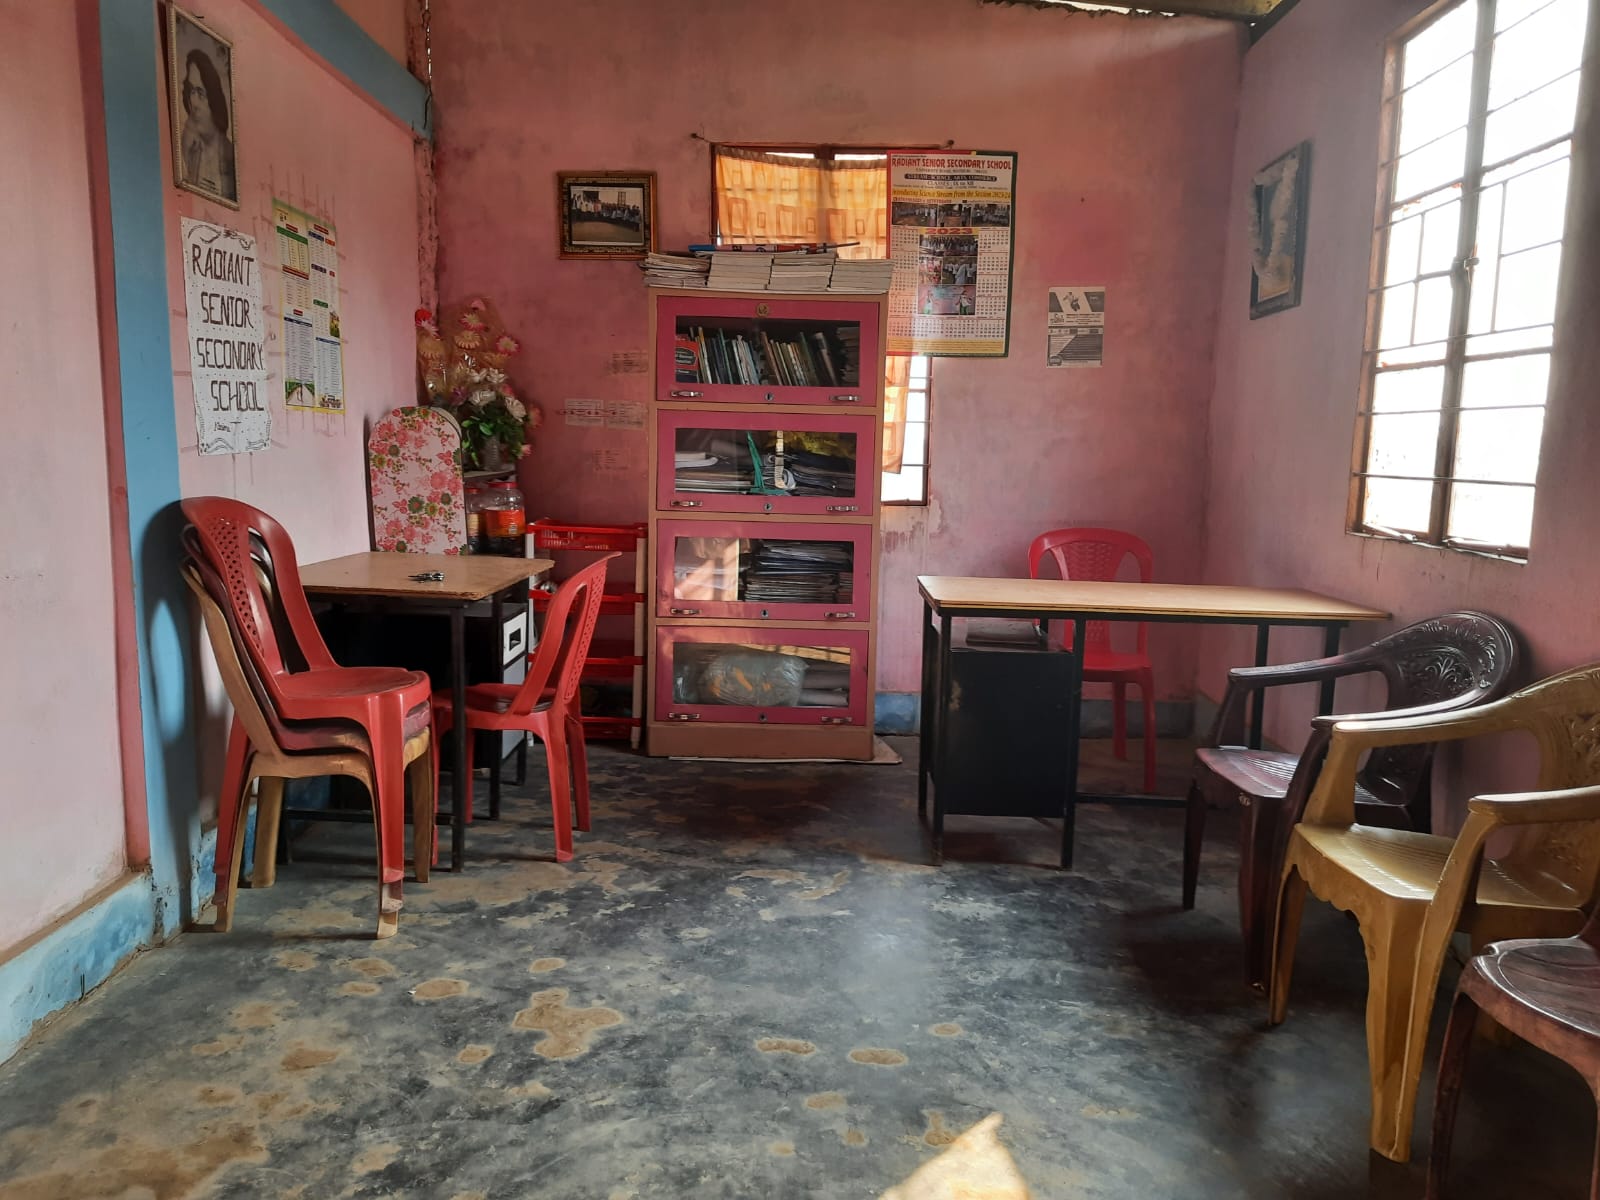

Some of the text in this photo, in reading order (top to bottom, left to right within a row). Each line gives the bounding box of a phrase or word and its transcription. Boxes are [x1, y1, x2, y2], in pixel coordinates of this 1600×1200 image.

[892, 158, 1012, 170] RADIANT SENIOR SECONDARY SCHOOL
[925, 227, 973, 235] 2023
[192, 243, 254, 286] RADIANT
[200, 291, 254, 329] SENIOR
[196, 337, 264, 371] SECONDARY
[211, 380, 265, 412] SCHOOL
